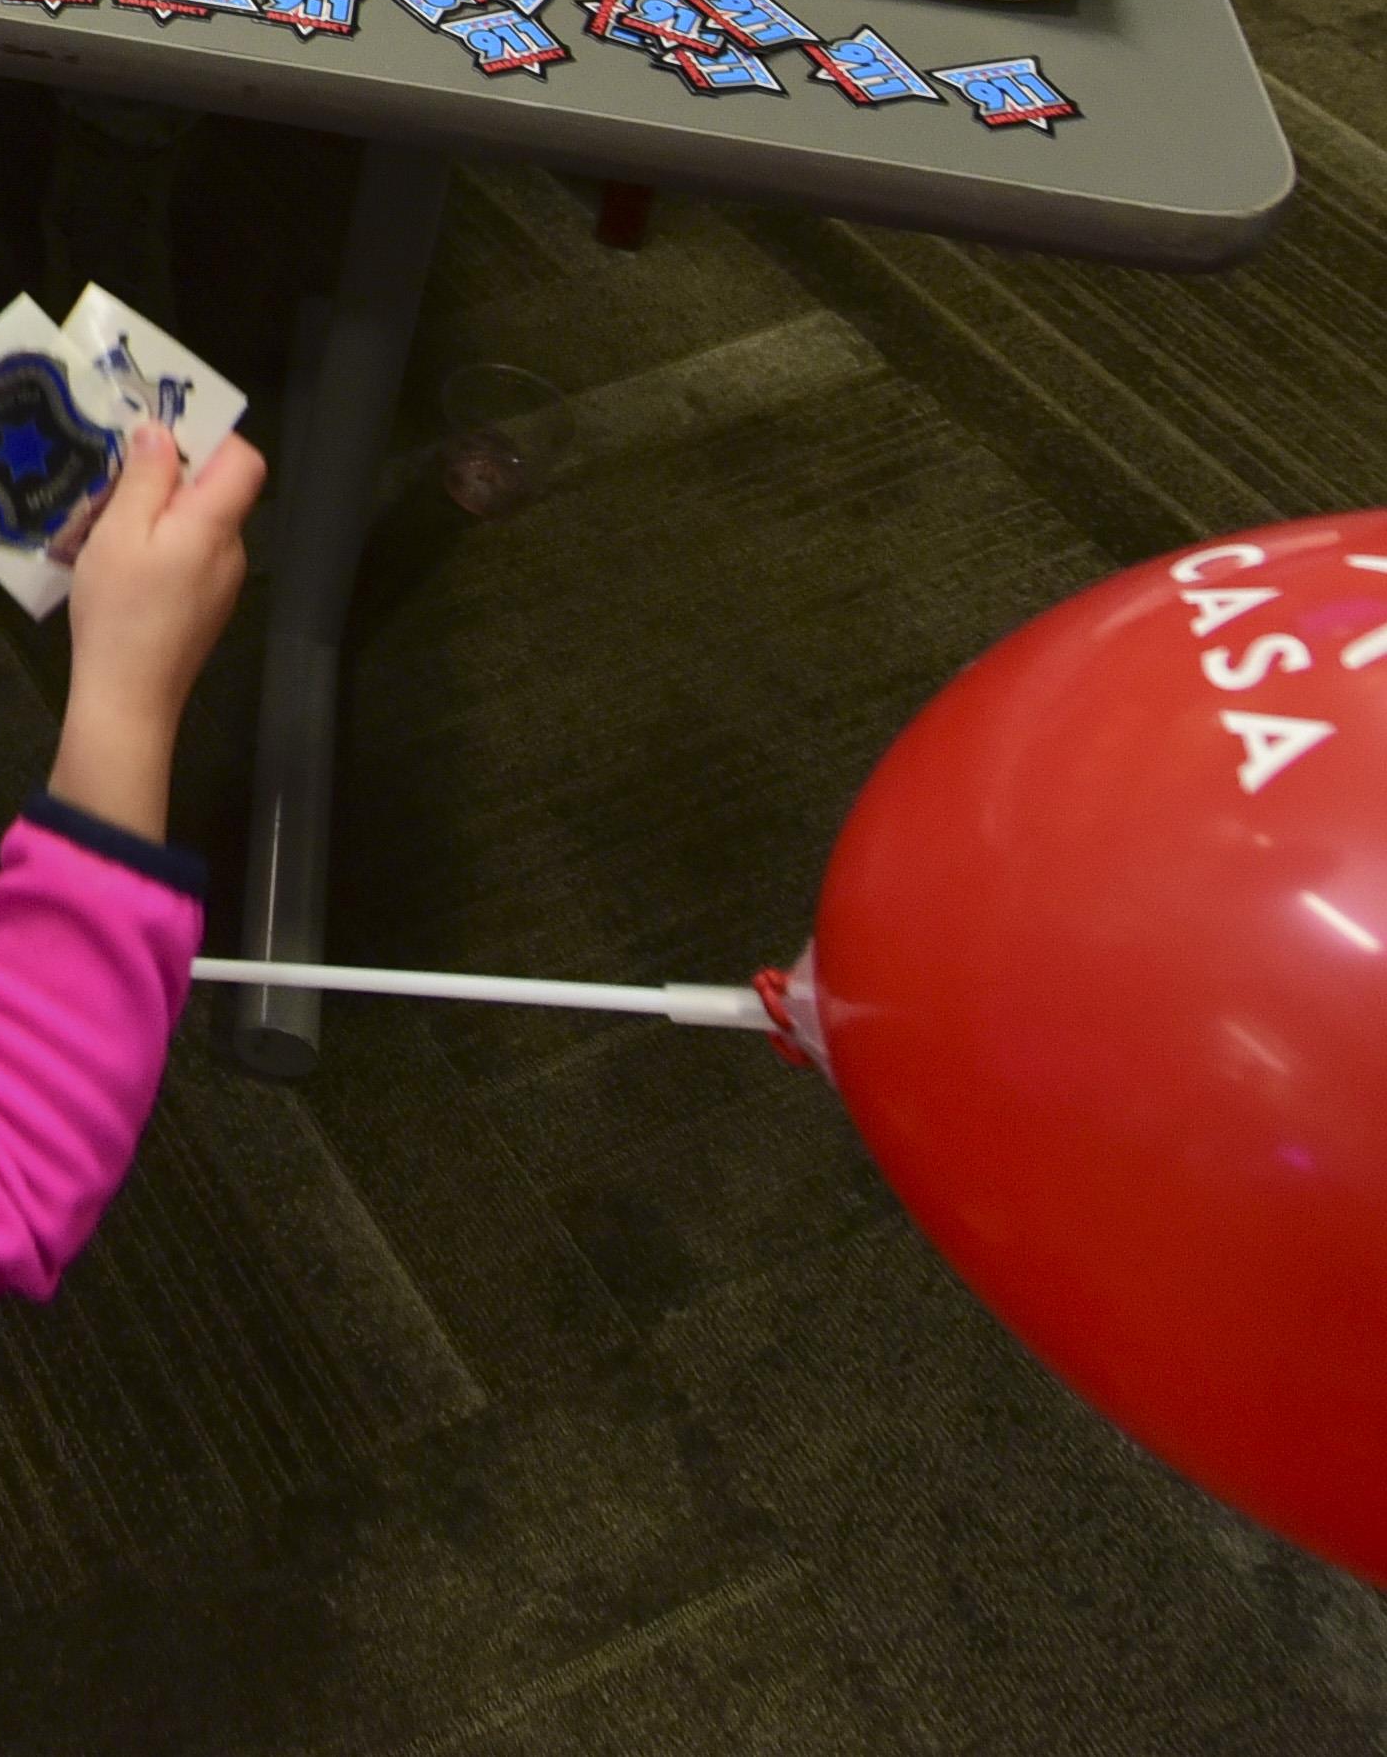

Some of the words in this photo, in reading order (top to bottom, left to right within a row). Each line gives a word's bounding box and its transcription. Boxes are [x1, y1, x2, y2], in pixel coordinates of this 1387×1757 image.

[267, 10, 351, 35] MERGENCY
[466, 20, 556, 60] 911
[828, 42, 913, 97] 911
[964, 71, 1059, 113] 911
[1169, 543, 1339, 796] CASA
